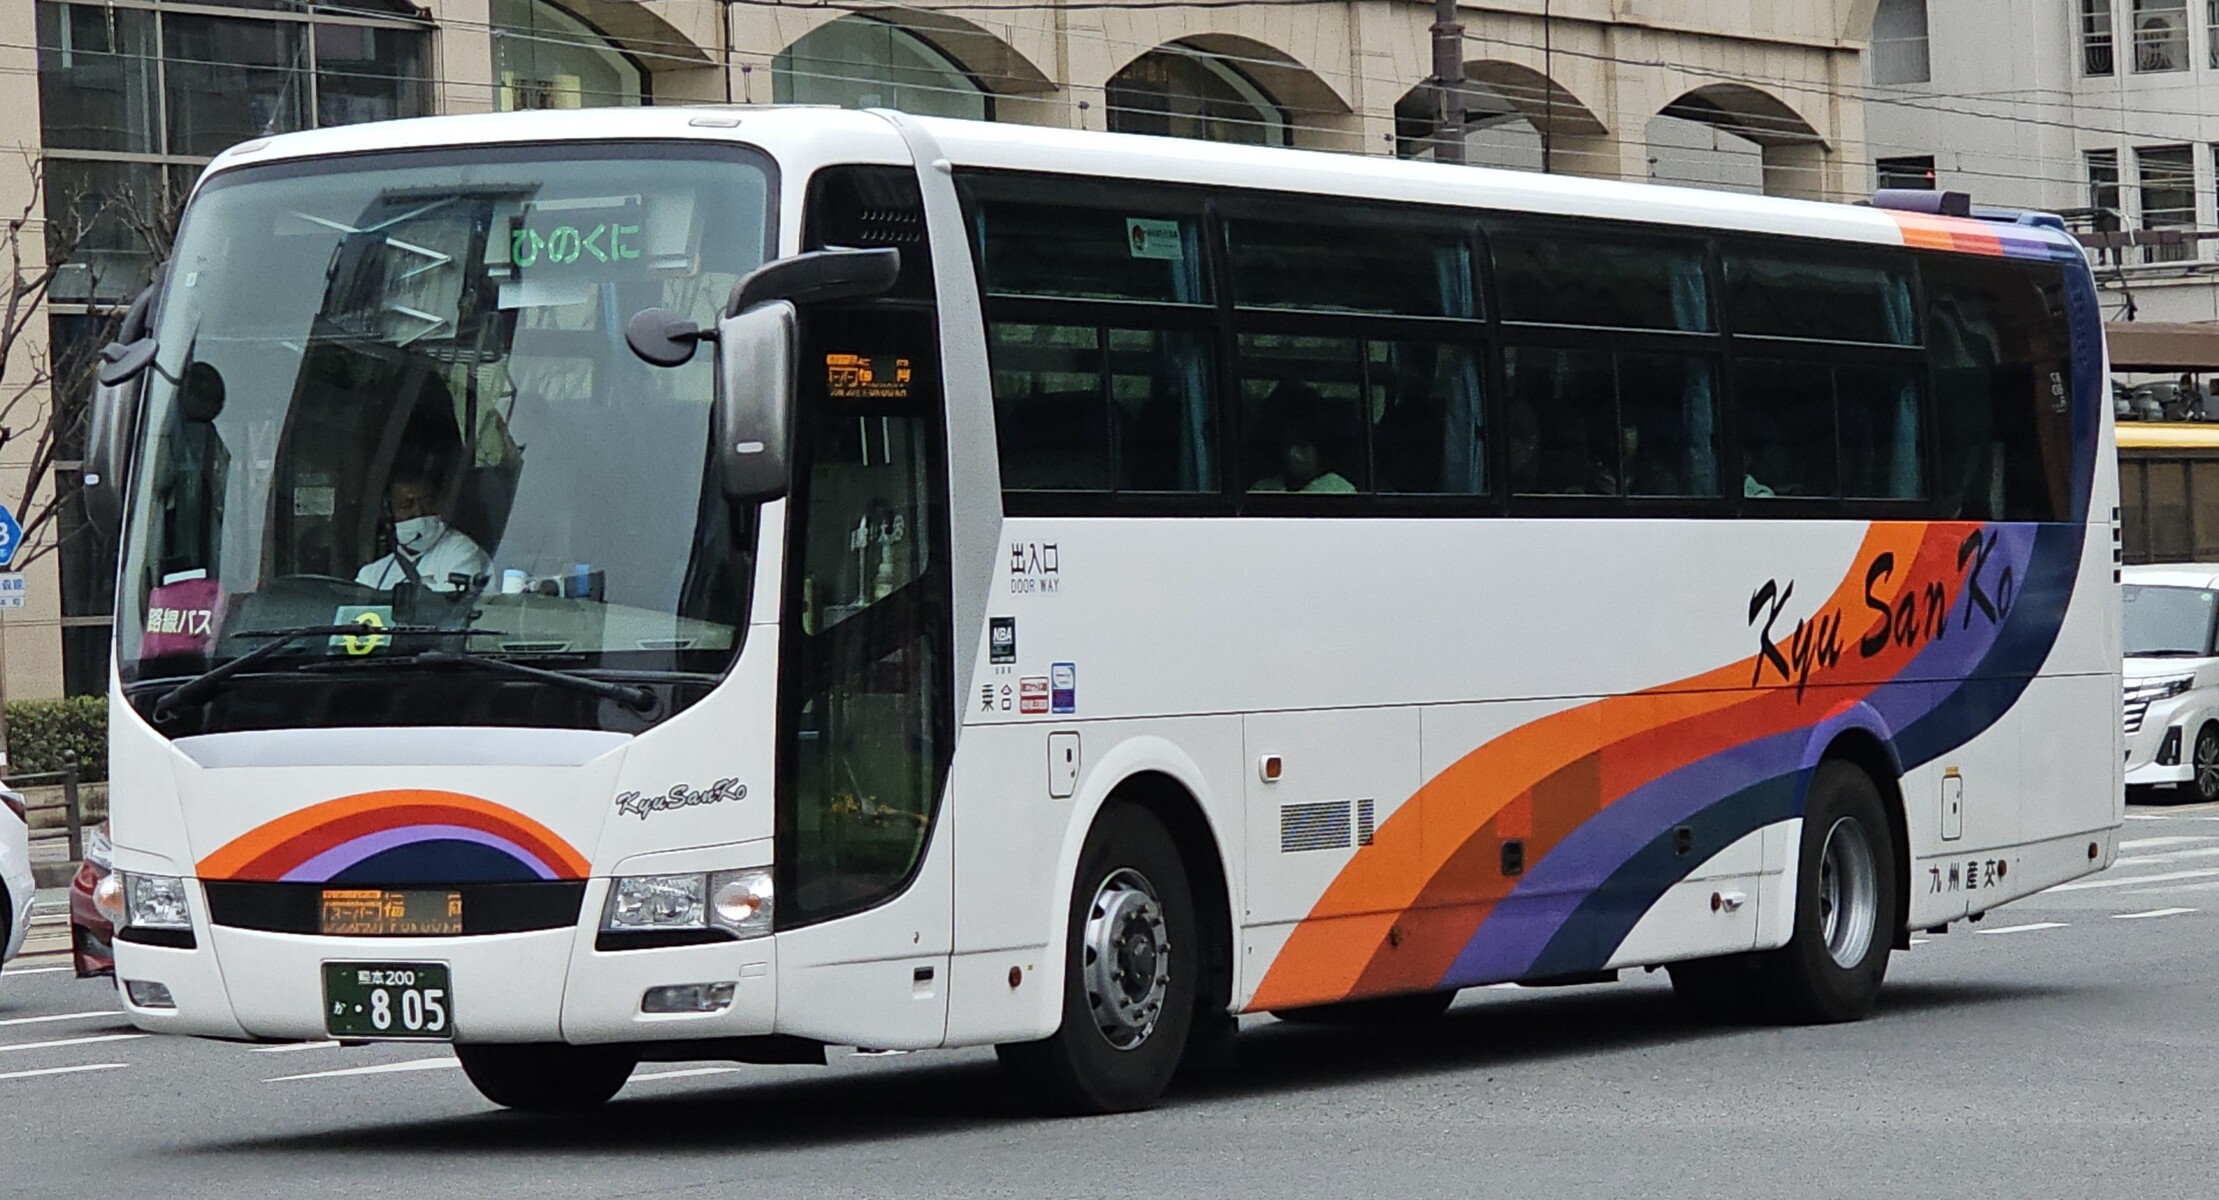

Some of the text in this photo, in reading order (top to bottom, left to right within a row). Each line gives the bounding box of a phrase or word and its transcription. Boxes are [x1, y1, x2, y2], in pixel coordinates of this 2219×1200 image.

[512, 224, 641, 267] ひのくに
[1010, 543, 1059, 574] 出入口
[1011, 578, 1060, 593] DOOR WAY
[146, 608, 213, 635] 路線バス
[1749, 528, 2014, 705] Kyu San Ko
[981, 684, 1013, 712] 乗合
[615, 777, 748, 821] KyuSanKo
[1929, 859, 1997, 894] 九州産交
